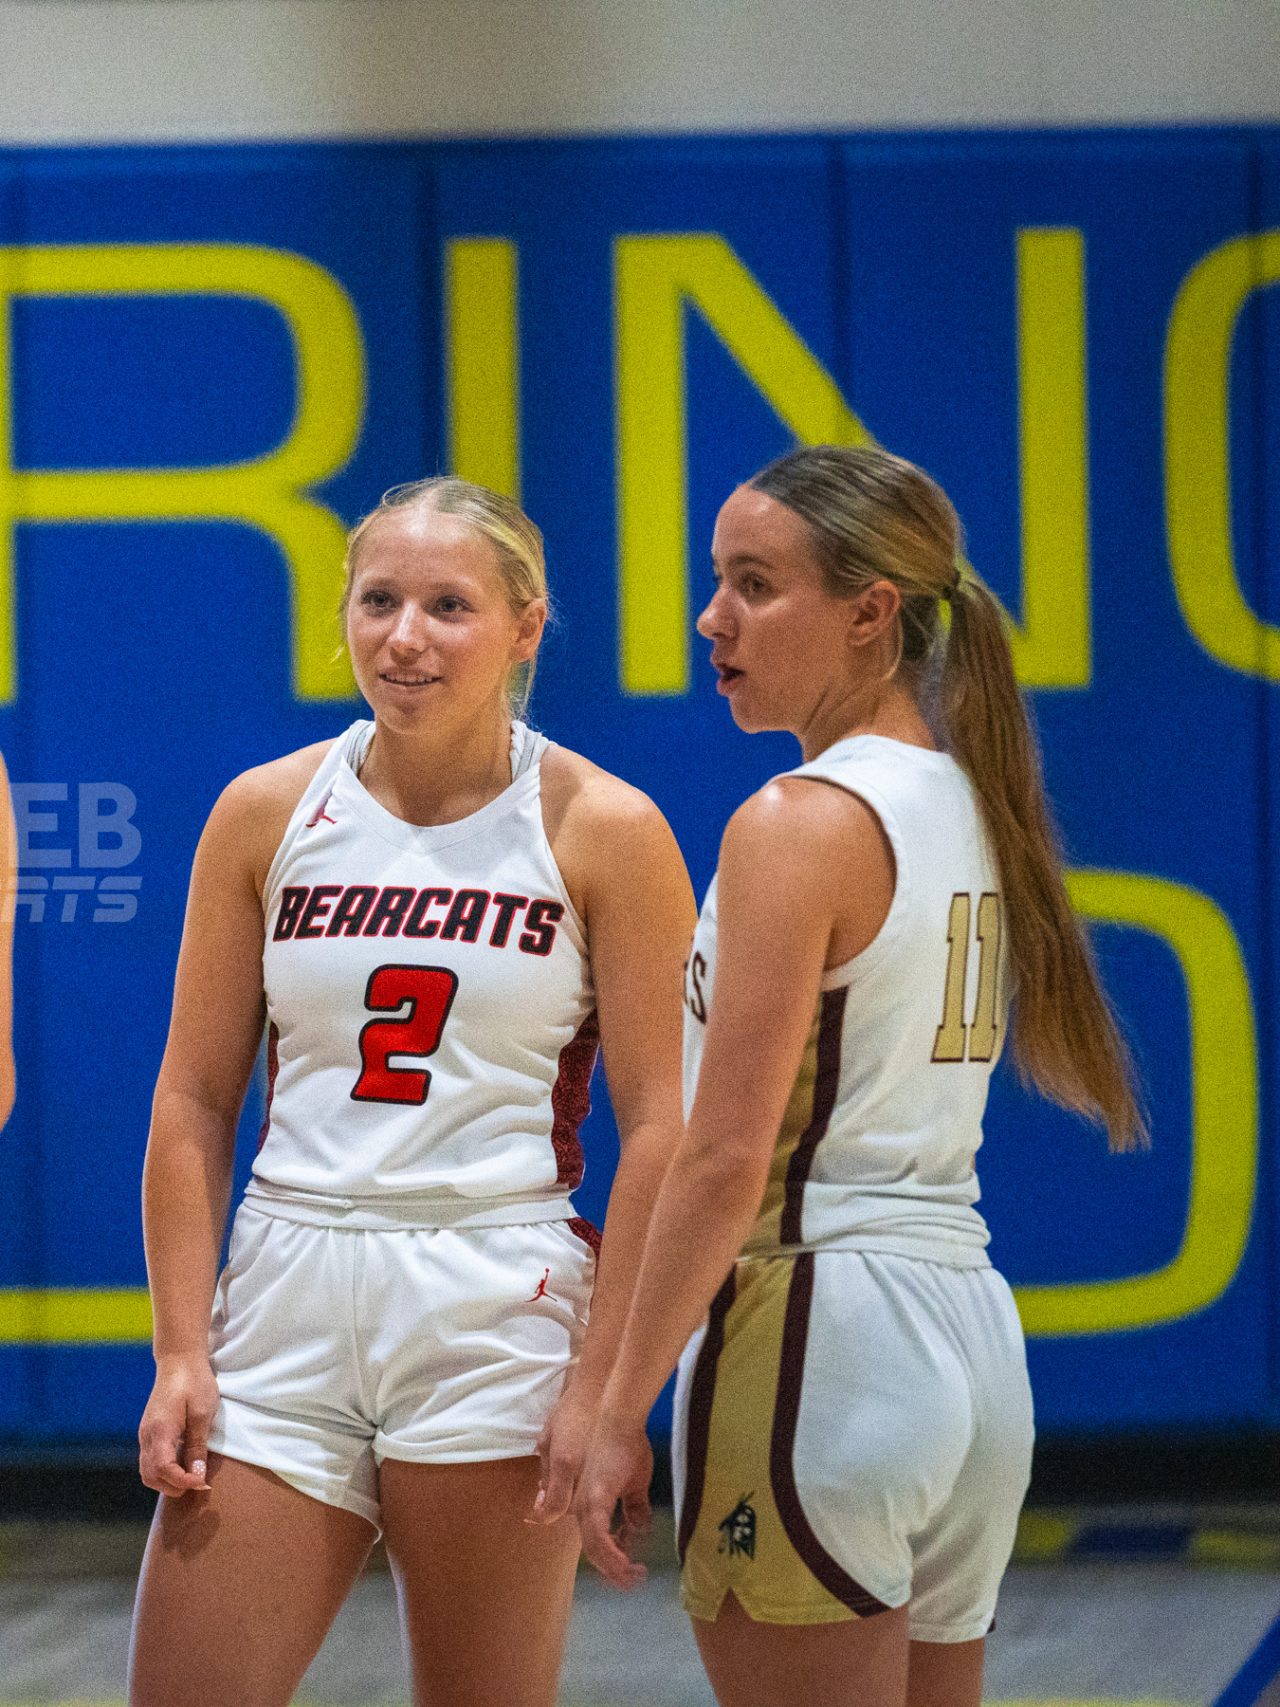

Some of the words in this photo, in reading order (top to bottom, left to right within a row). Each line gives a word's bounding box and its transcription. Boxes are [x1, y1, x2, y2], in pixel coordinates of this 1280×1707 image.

[272, 885, 565, 957] BEARCATS
[930, 891, 1002, 1063] 11
[350, 963, 459, 1106] 2
